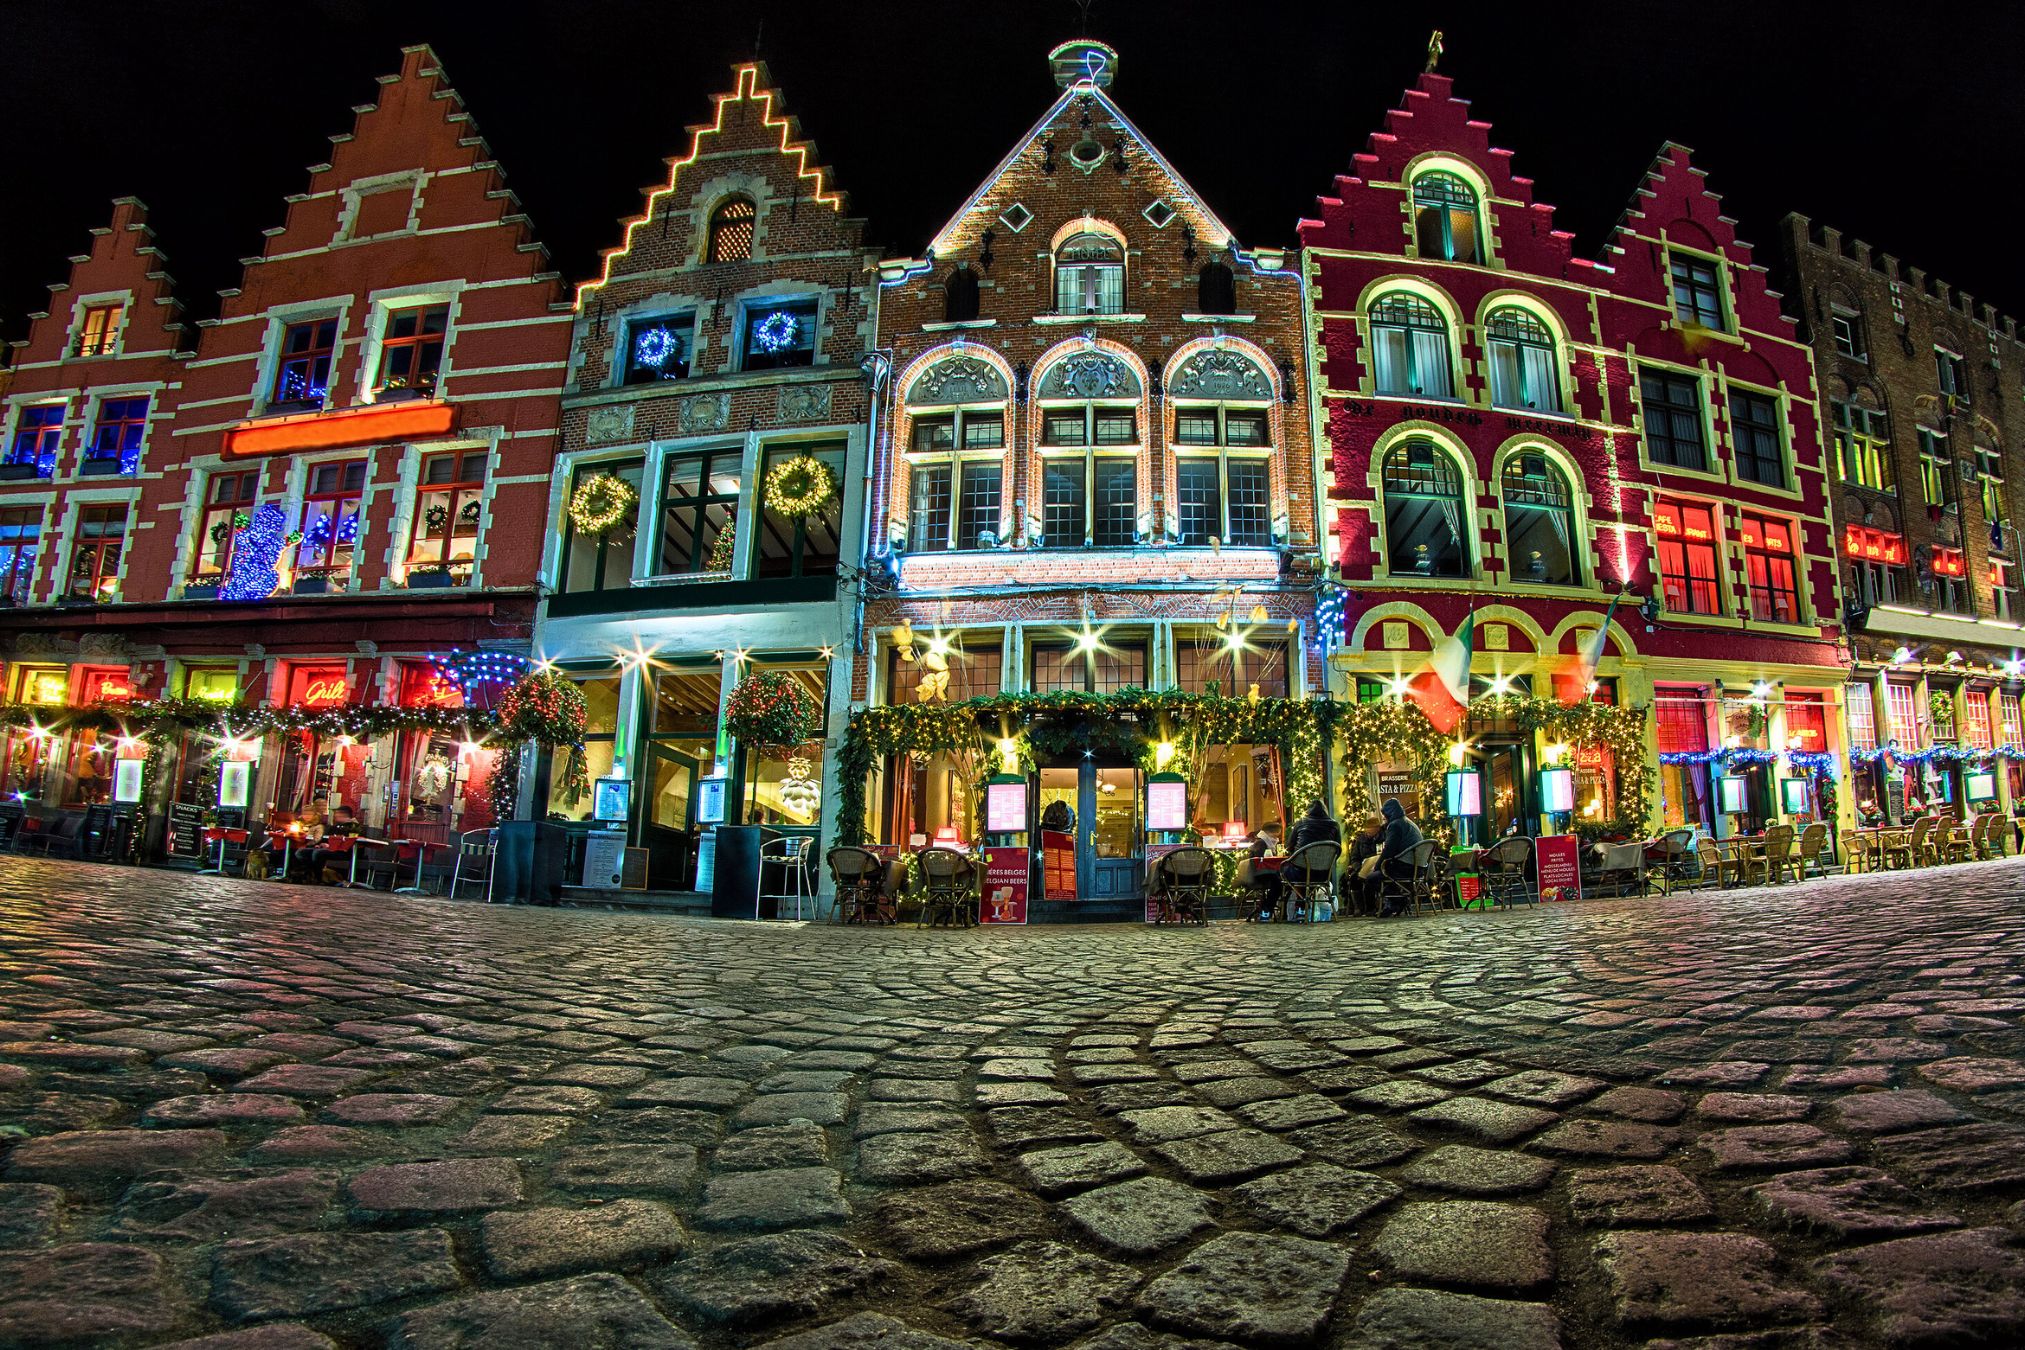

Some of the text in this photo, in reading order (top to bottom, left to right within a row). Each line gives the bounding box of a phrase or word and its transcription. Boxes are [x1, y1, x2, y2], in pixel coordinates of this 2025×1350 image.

[1743, 534, 1754, 543] ES
[305, 680, 347, 704] Grill
[1393, 784, 1399, 793] &
[1399, 783, 1419, 793] PIZZA
[175, 804, 198, 813] SNACKS
